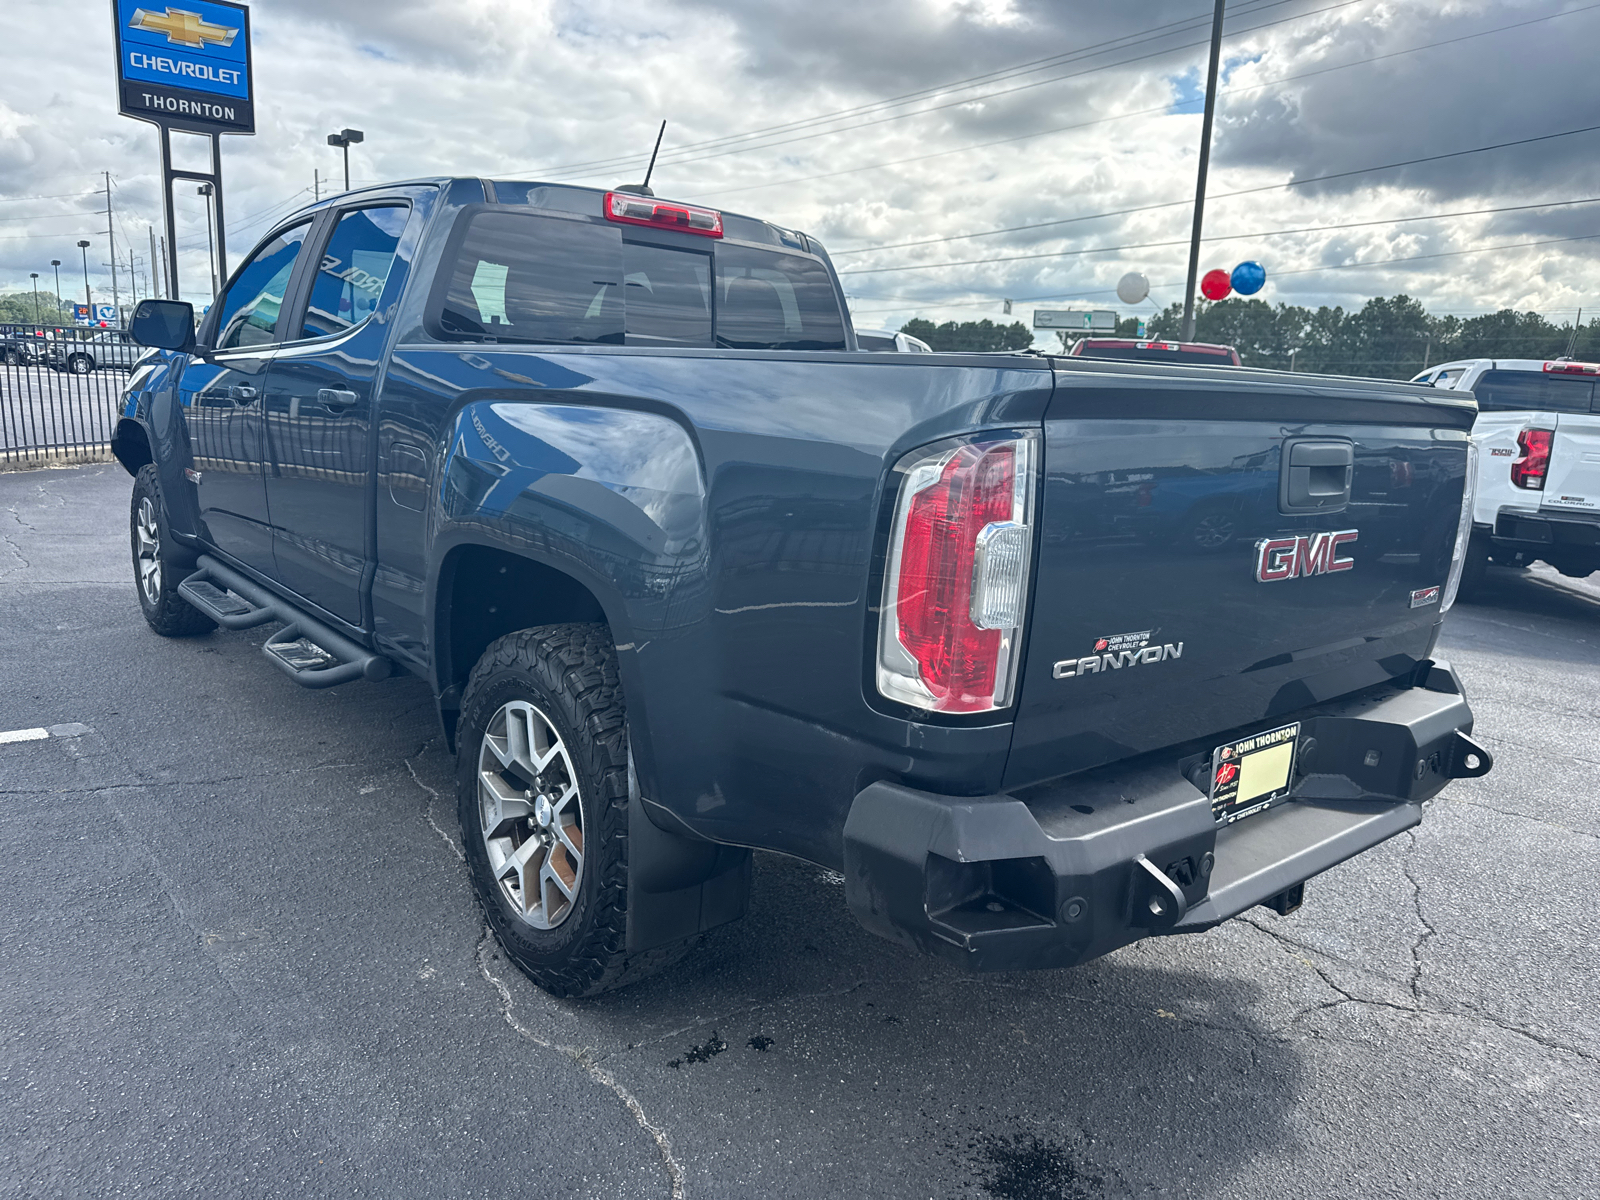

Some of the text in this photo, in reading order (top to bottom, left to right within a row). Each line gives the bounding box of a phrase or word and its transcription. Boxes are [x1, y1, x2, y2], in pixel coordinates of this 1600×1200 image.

[130, 52, 241, 85] CHEVROLET
[142, 93, 235, 121] THORNTON
[1252, 529, 1360, 584] GMC
[1108, 641, 1139, 652] CHEVROLET
[1109, 633, 1150, 645] JOHN THORNTON
[1051, 641, 1184, 681] CANYON
[1236, 726, 1297, 754] JOHN THORNTON
[1236, 806, 1262, 819] CHEVROLET
